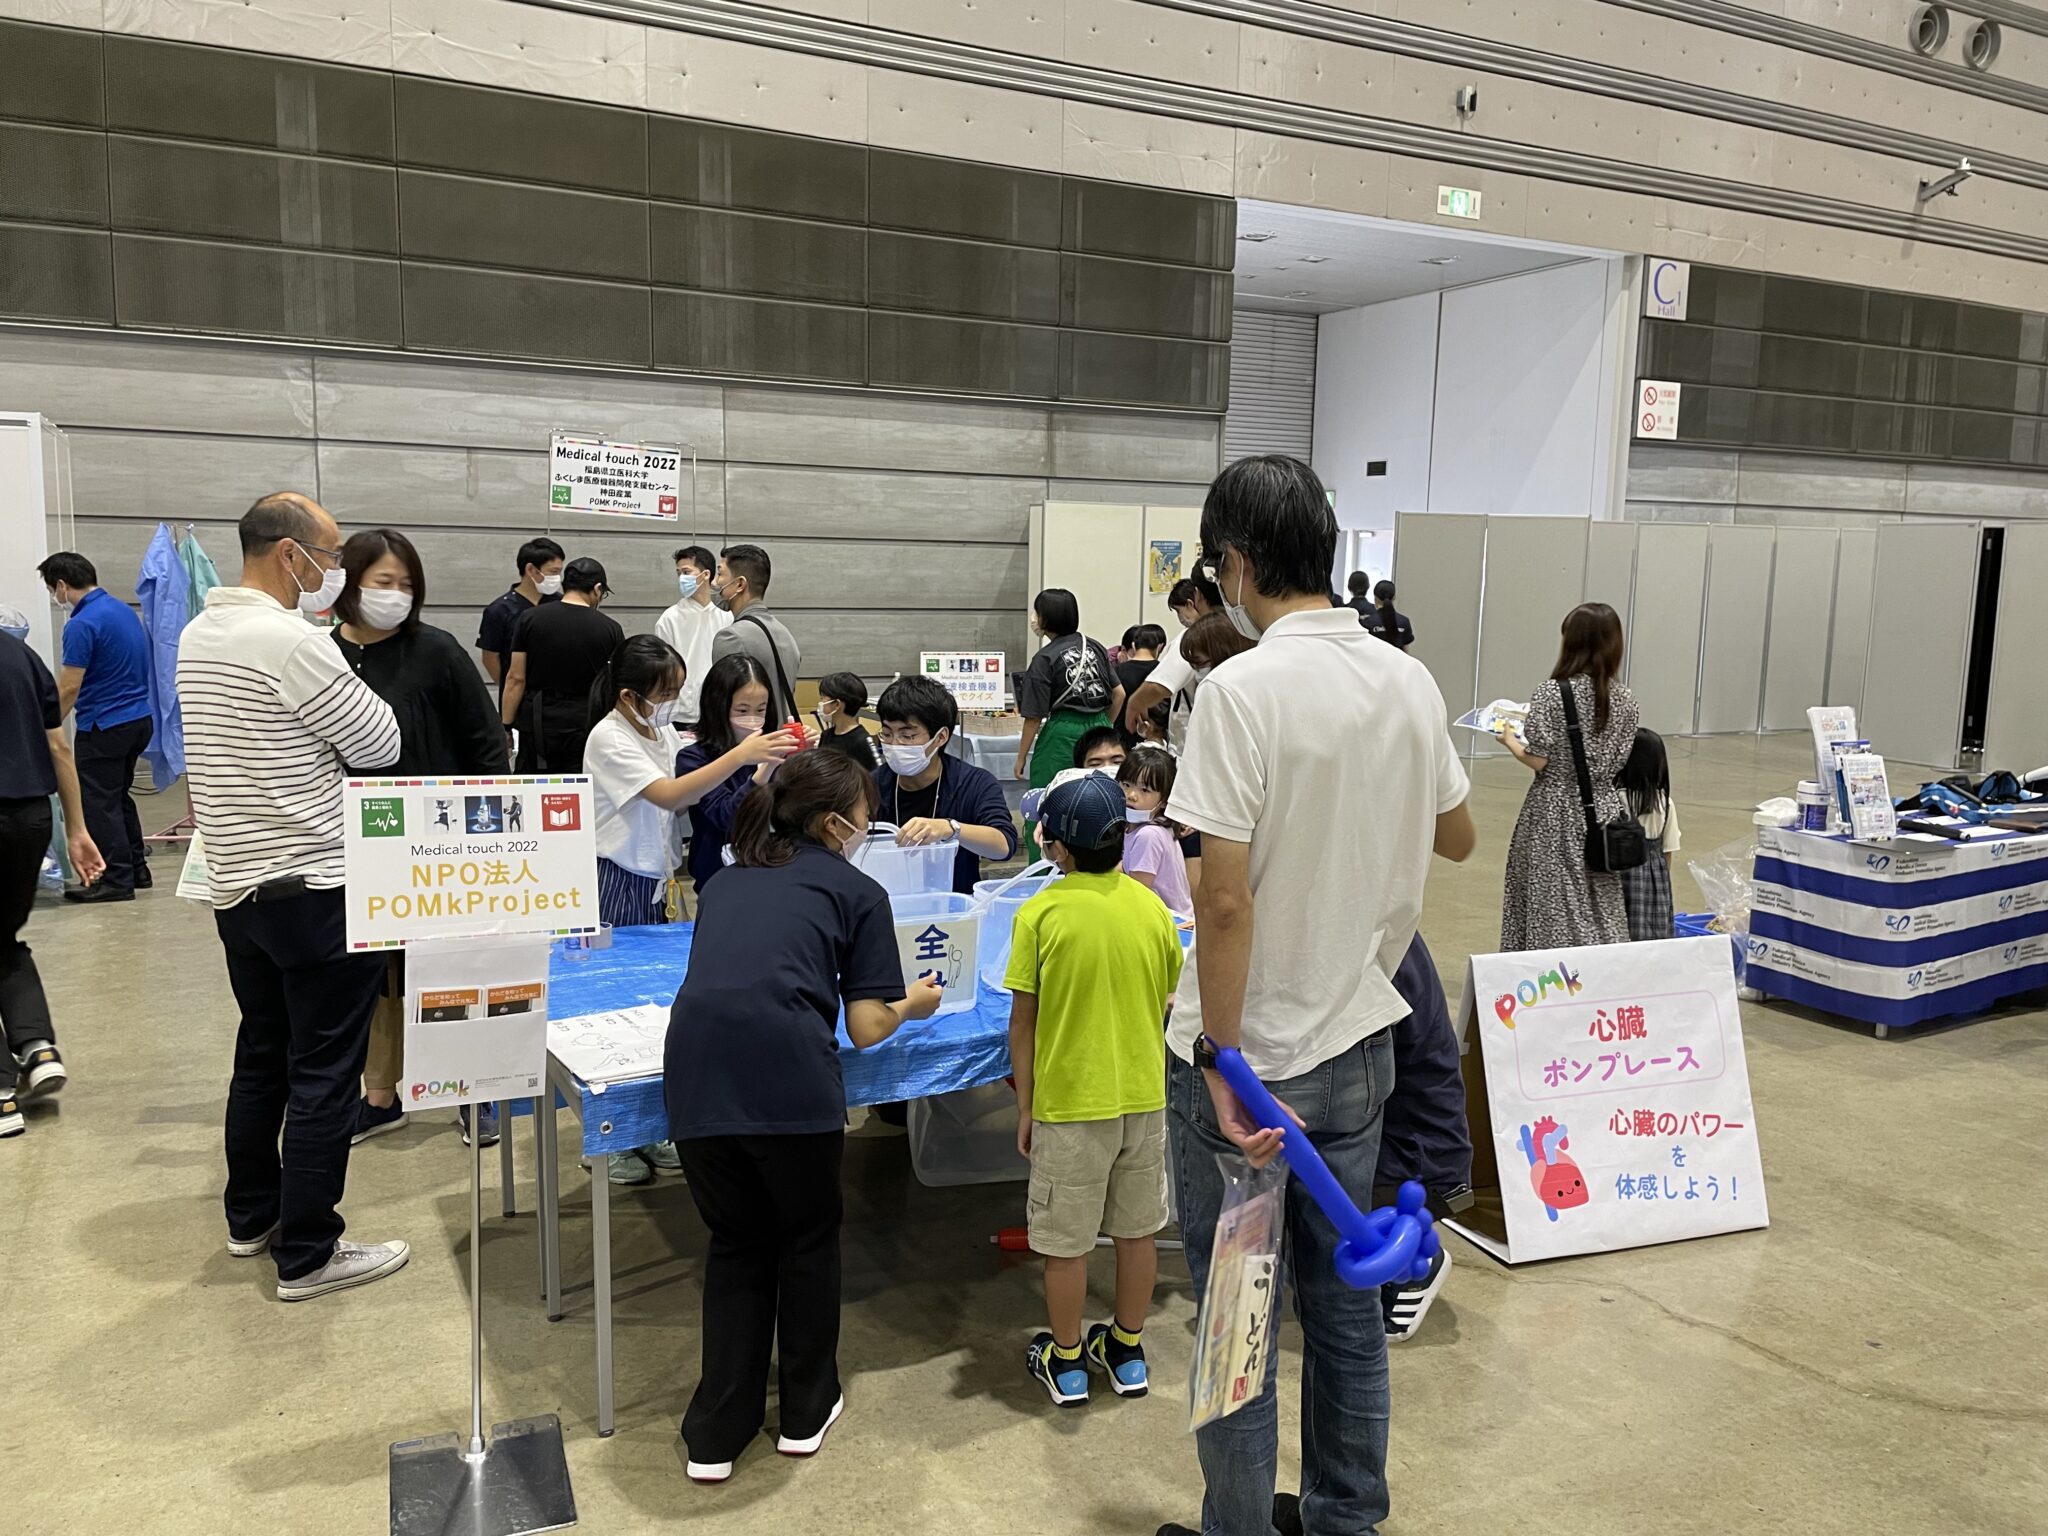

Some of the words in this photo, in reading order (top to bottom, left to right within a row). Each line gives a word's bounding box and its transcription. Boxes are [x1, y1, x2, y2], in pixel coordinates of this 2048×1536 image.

[1657, 304, 1675, 317] Hall
[556, 446, 601, 462] Medical
[605, 451, 639, 466] touch
[644, 456, 676, 470] 2022
[585, 465, 649, 479] 福島県立医科大学
[554, 473, 677, 491] ふくしま医療機器開発支援センター
[589, 498, 610, 506] POMK
[613, 500, 641, 509] Project
[946, 681, 997, 691] 波検査機器
[955, 692, 993, 701] でクイズ
[363, 800, 370, 810] 3
[543, 796, 549, 805] 4
[411, 843, 463, 857] Medical
[467, 842, 503, 854] touch
[507, 840, 538, 853] 2022
[412, 859, 539, 888] NPO法人
[368, 887, 581, 920] POMkProject
[1589, 1005, 1647, 1041] 心臓
[1544, 1046, 1700, 1087] ポンプレース
[1609, 1108, 1744, 1137] 心臓のパワー
[1672, 1145, 1687, 1167] を
[1615, 1174, 1737, 1201] 体感しよう！
